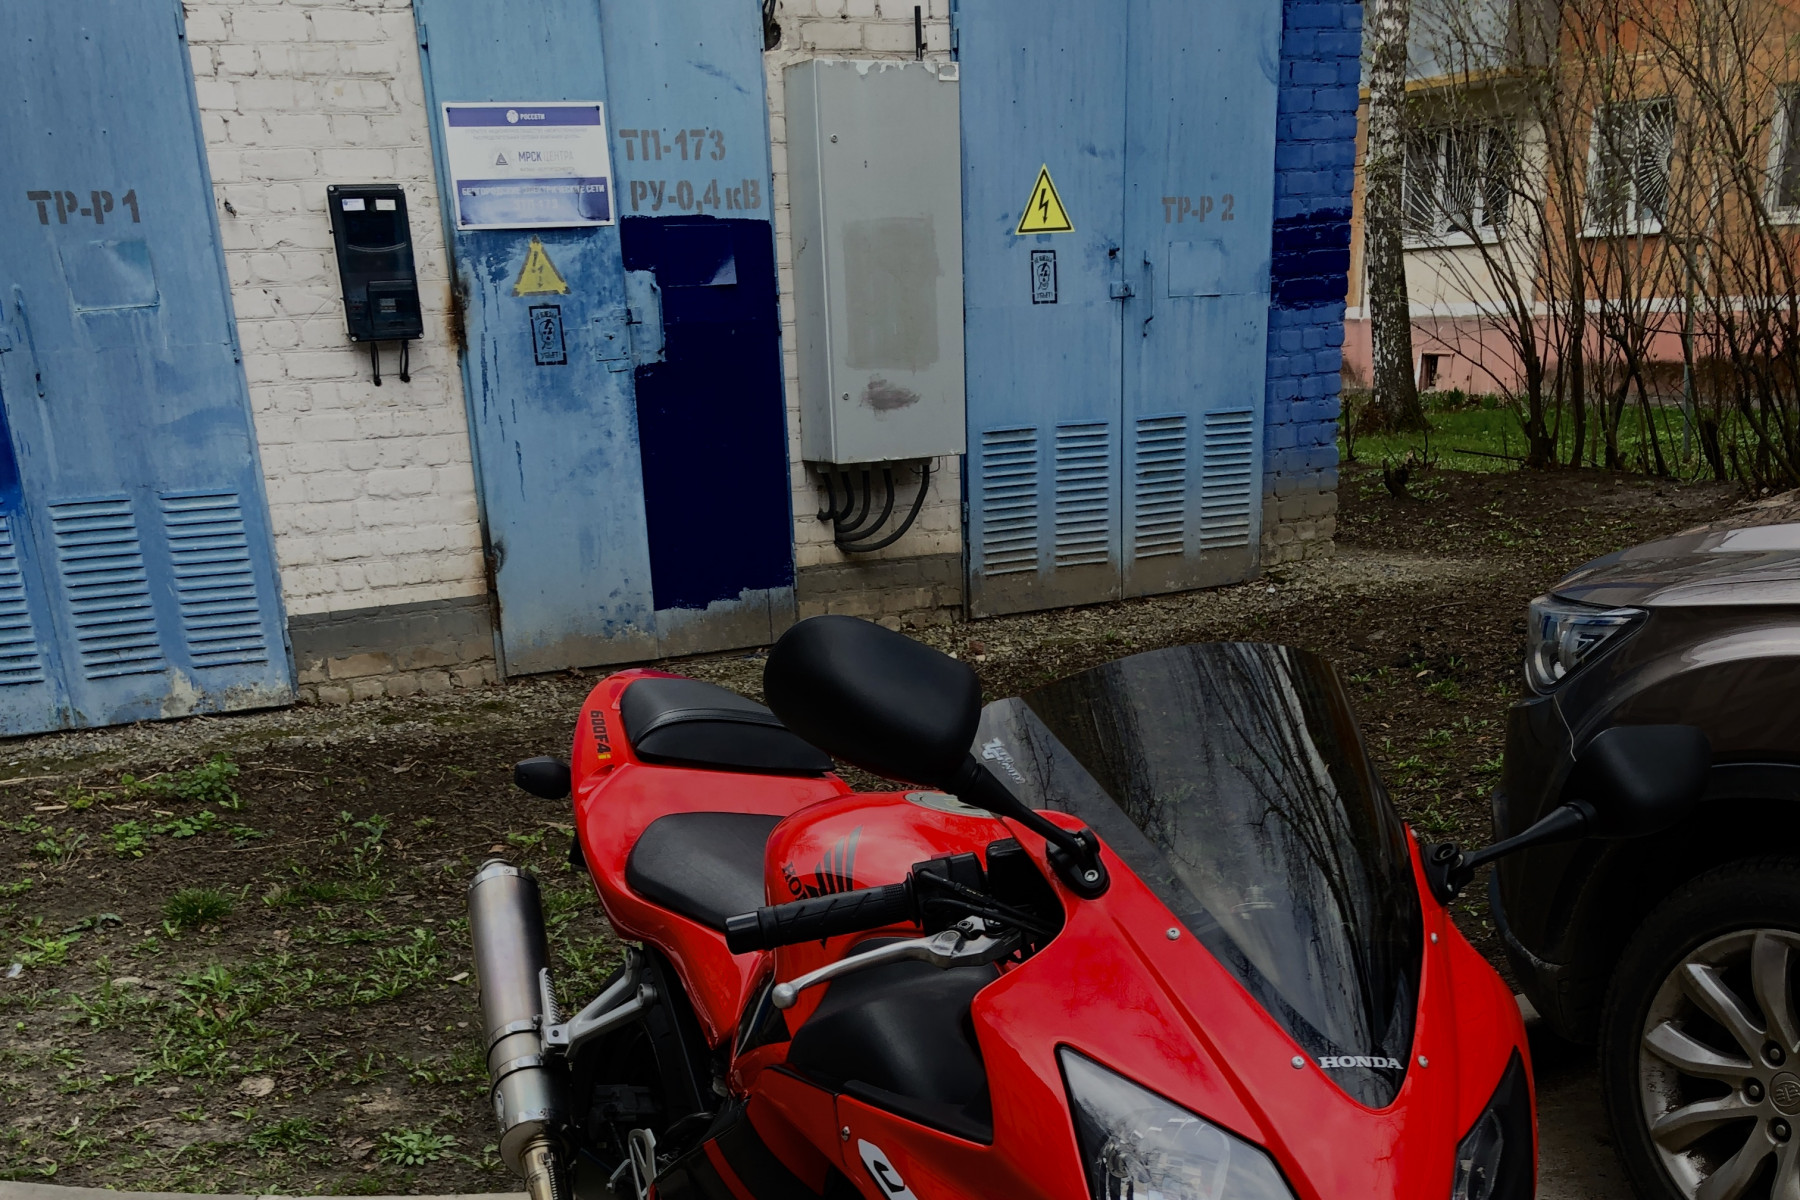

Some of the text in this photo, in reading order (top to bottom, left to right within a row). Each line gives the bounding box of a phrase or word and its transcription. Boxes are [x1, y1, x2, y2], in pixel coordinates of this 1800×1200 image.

[519, 113, 546, 121] РОССЕТИ
[619, 128, 726, 161] ТП-173
[518, 150, 575, 163] МРСК ЦЕНТРА
[586, 184, 605, 193] СЕТИ
[27, 189, 141, 225] ТР-Р 1
[1161, 193, 1235, 224] ТР-Р 2
[1317, 1055, 1405, 1070] HONDA
